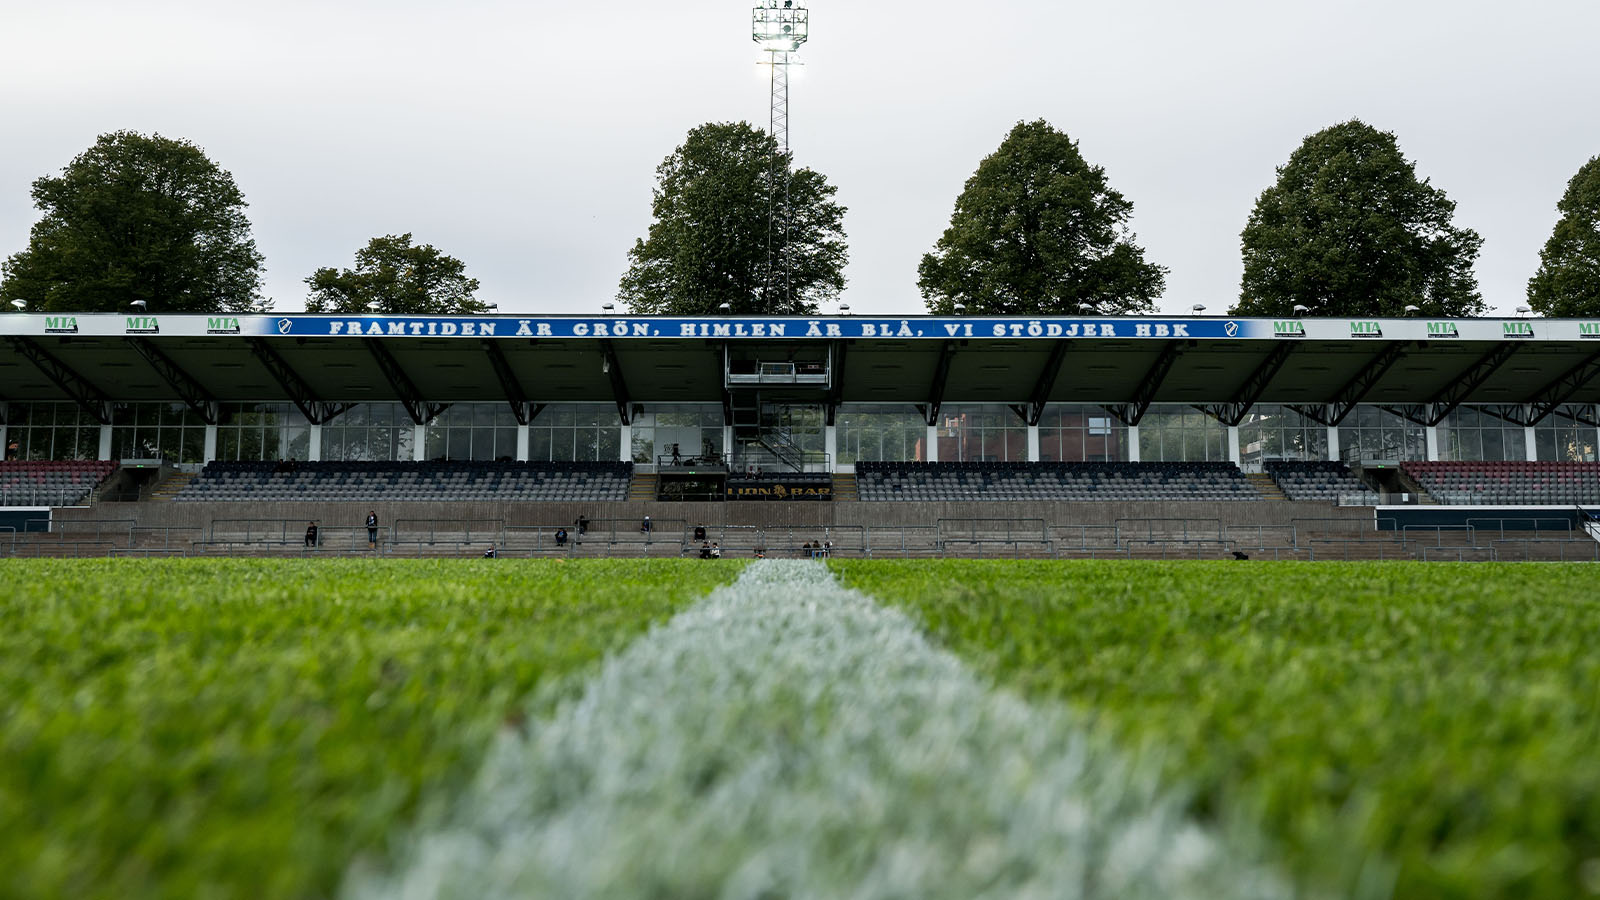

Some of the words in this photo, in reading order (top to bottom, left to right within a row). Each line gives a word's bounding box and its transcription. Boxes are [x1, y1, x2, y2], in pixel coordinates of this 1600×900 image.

[45, 317, 78, 329] MTA
[127, 317, 159, 329] MTA
[207, 317, 240, 329] MTA
[328, 321, 496, 336] FRAMTIDEN
[515, 320, 553, 336] ÄR
[572, 320, 660, 337] GRÖN,
[679, 323, 786, 337] HIMLEN
[805, 320, 842, 337] ÄR
[861, 320, 923, 337] BLÅ,
[943, 323, 973, 337] VI
[992, 320, 1116, 337] STÖDJER
[1135, 323, 1189, 337] HBK
[1273, 321, 1305, 333] MTA
[1350, 321, 1382, 333] MTA
[1427, 322, 1458, 334] MTA
[1503, 322, 1534, 334] MTA
[727, 487, 770, 496] LION
[790, 487, 831, 496] BAR
